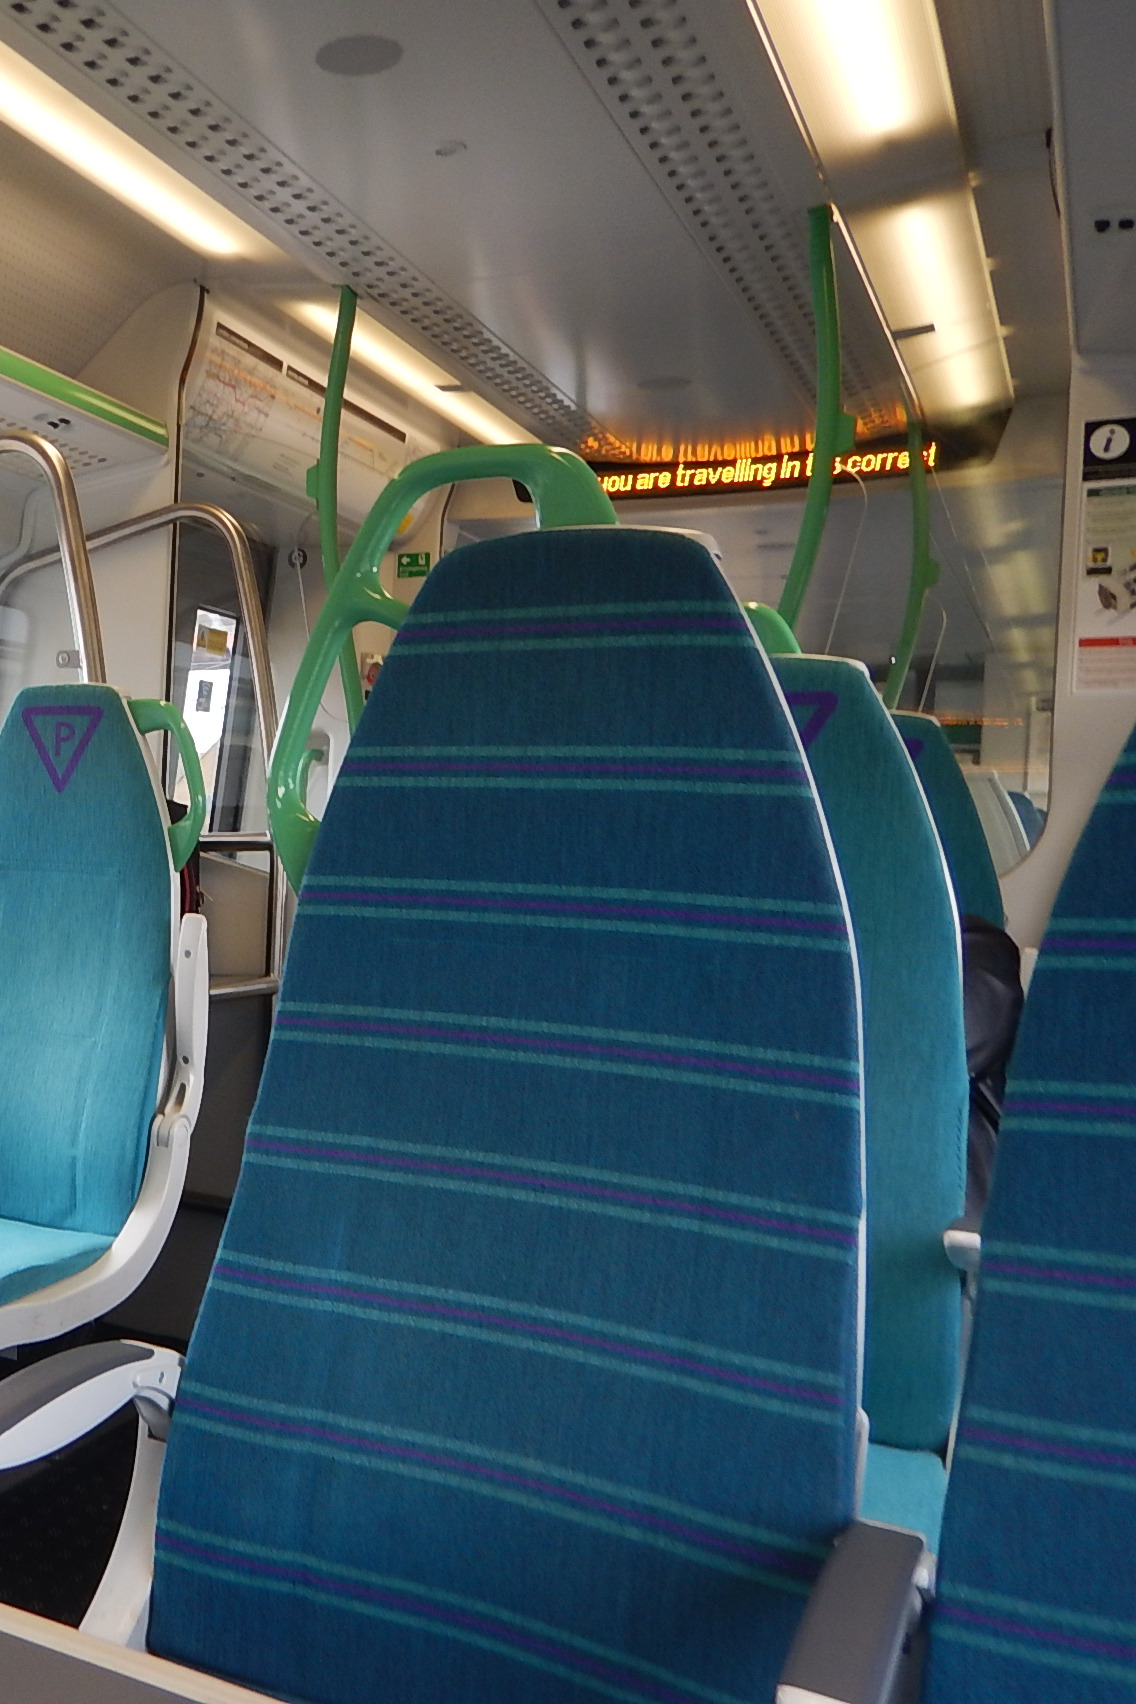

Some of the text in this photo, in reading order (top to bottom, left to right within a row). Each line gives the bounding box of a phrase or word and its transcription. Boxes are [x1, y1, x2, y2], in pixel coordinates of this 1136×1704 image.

[636, 471, 671, 490] are
[676, 458, 776, 487] travelling
[780, 454, 801, 479] in
[847, 441, 936, 474] corret
[54, 721, 75, 756] P
